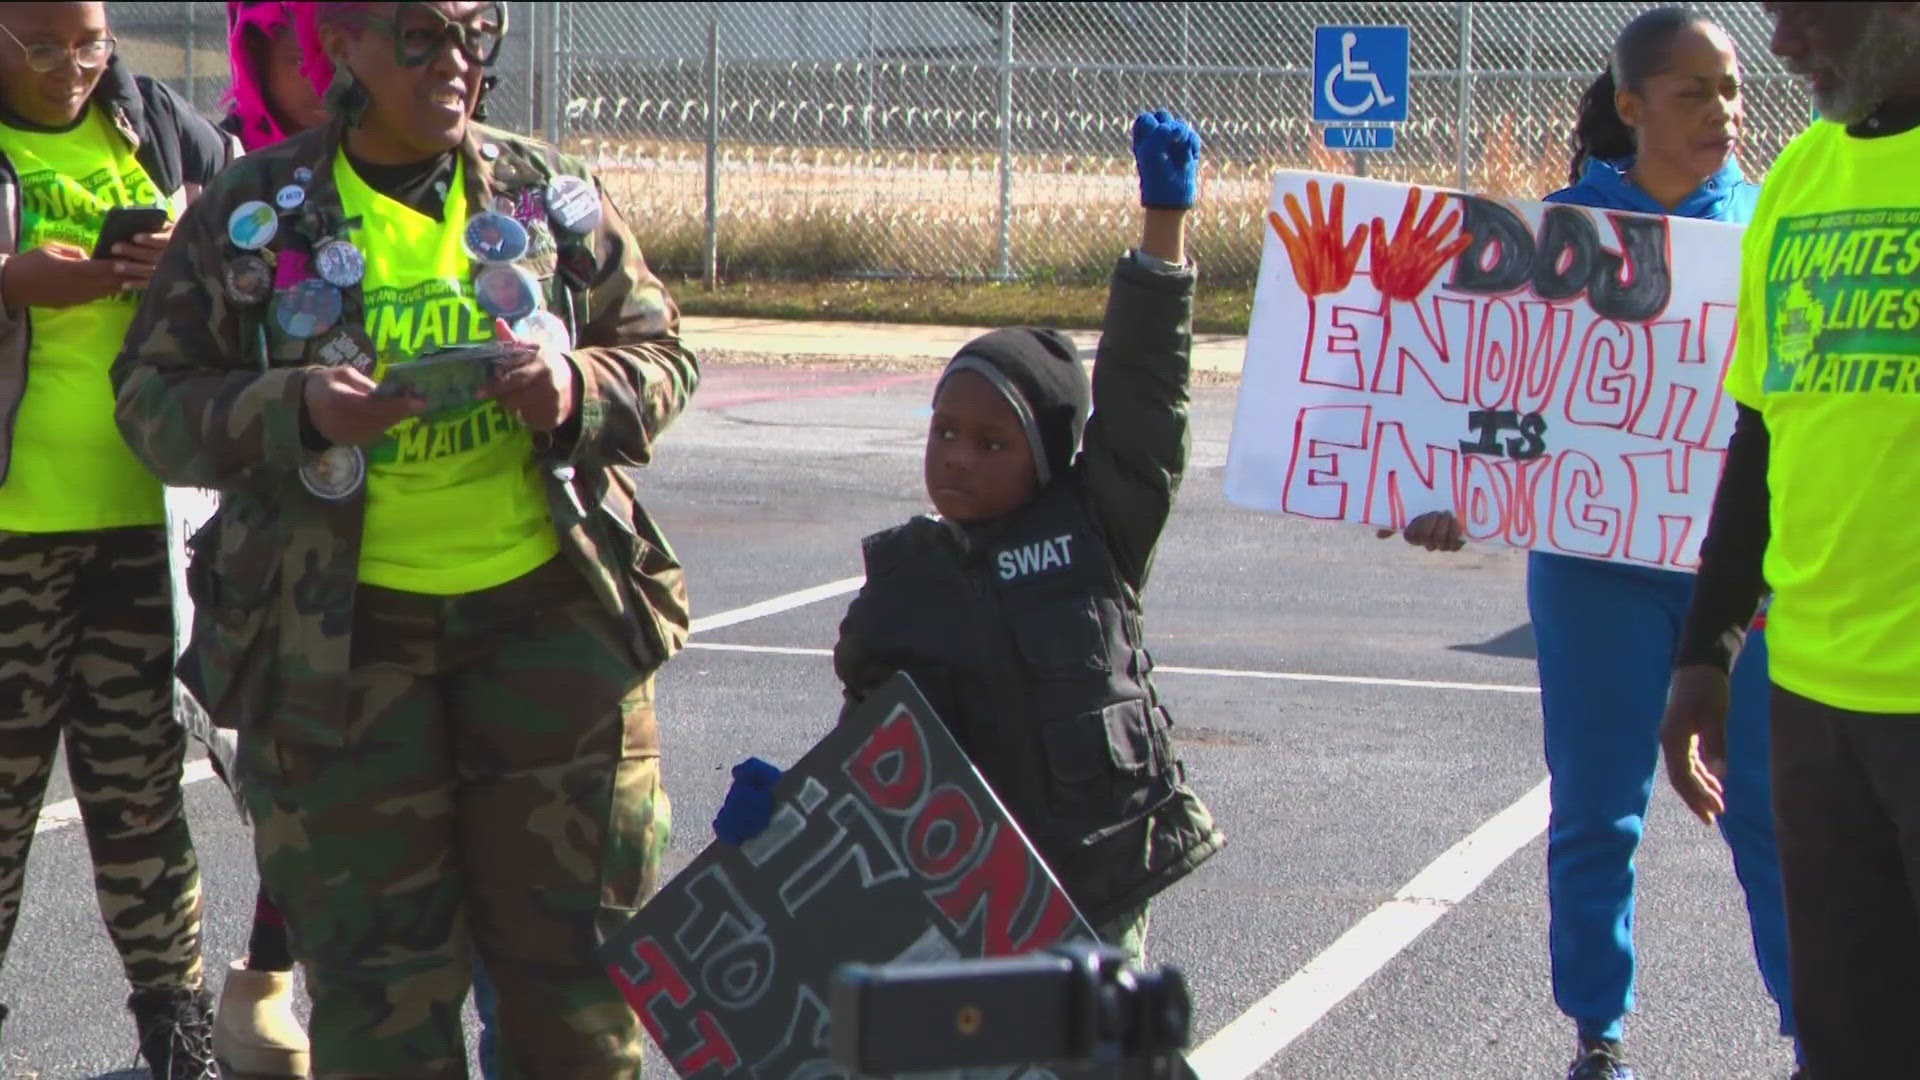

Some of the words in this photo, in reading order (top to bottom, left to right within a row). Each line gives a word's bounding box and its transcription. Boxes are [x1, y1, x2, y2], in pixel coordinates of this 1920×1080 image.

[1342, 128, 1377, 146] VAN
[1443, 193, 1672, 322] DOJ
[1769, 228, 1920, 283] INMATES
[1826, 288, 1920, 330] LIVES
[1300, 270, 1738, 449] ENOUGH
[1790, 352, 1920, 393] MATTER
[1459, 410, 1548, 460] IS
[1282, 404, 1727, 570] ENOUGH
[998, 533, 1073, 580] SWAT
[674, 864, 775, 1009] TO
